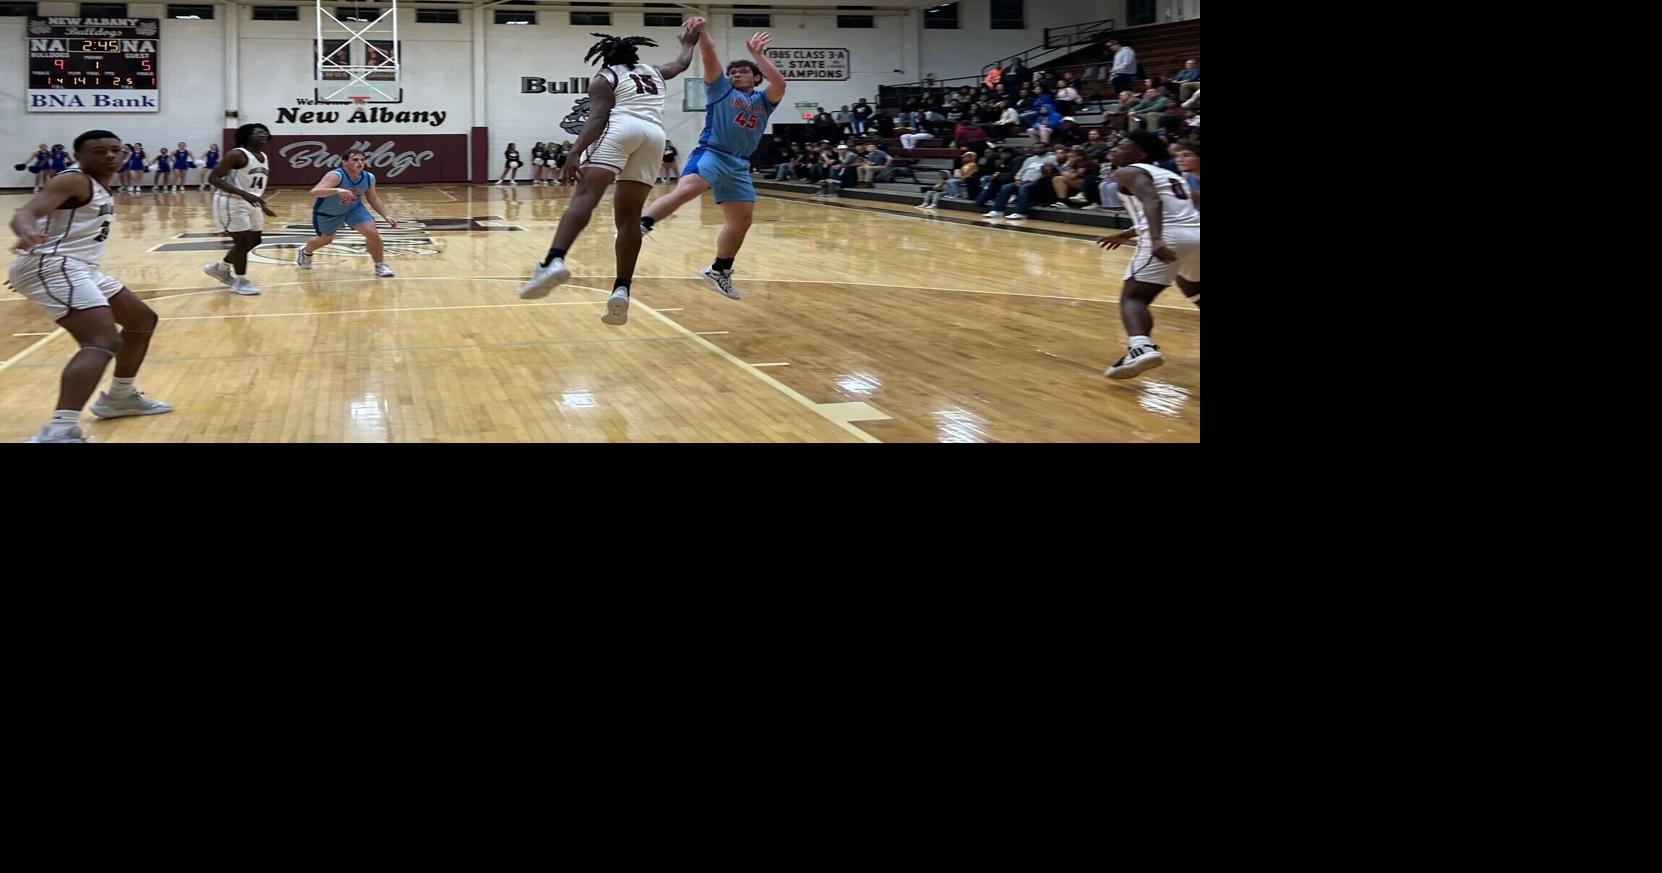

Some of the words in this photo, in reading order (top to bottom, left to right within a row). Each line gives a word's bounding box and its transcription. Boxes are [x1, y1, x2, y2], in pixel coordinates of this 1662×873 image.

[49, 17, 80, 26] NEW
[83, 18, 139, 26] ALBANY
[65, 28, 122, 37] Bulldogs
[31, 40, 65, 52] NA
[82, 40, 119, 51] 2:45
[122, 40, 156, 52] NA
[769, 51, 790, 59] 1985
[794, 51, 825, 59] CLASS
[828, 51, 844, 59] 3-A
[54, 59, 64, 70] 9
[141, 60, 151, 71] 5
[788, 60, 825, 69] STATE
[779, 70, 842, 78] HAMPIONS
[629, 73, 659, 95] 15
[32, 95, 85, 107] BNA
[94, 95, 156, 107] Bank
[275, 107, 340, 124] New
[347, 106, 447, 127] Albany
[733, 111, 759, 128] 45
[279, 140, 435, 178] Budogs
[250, 176, 264, 189] 14
